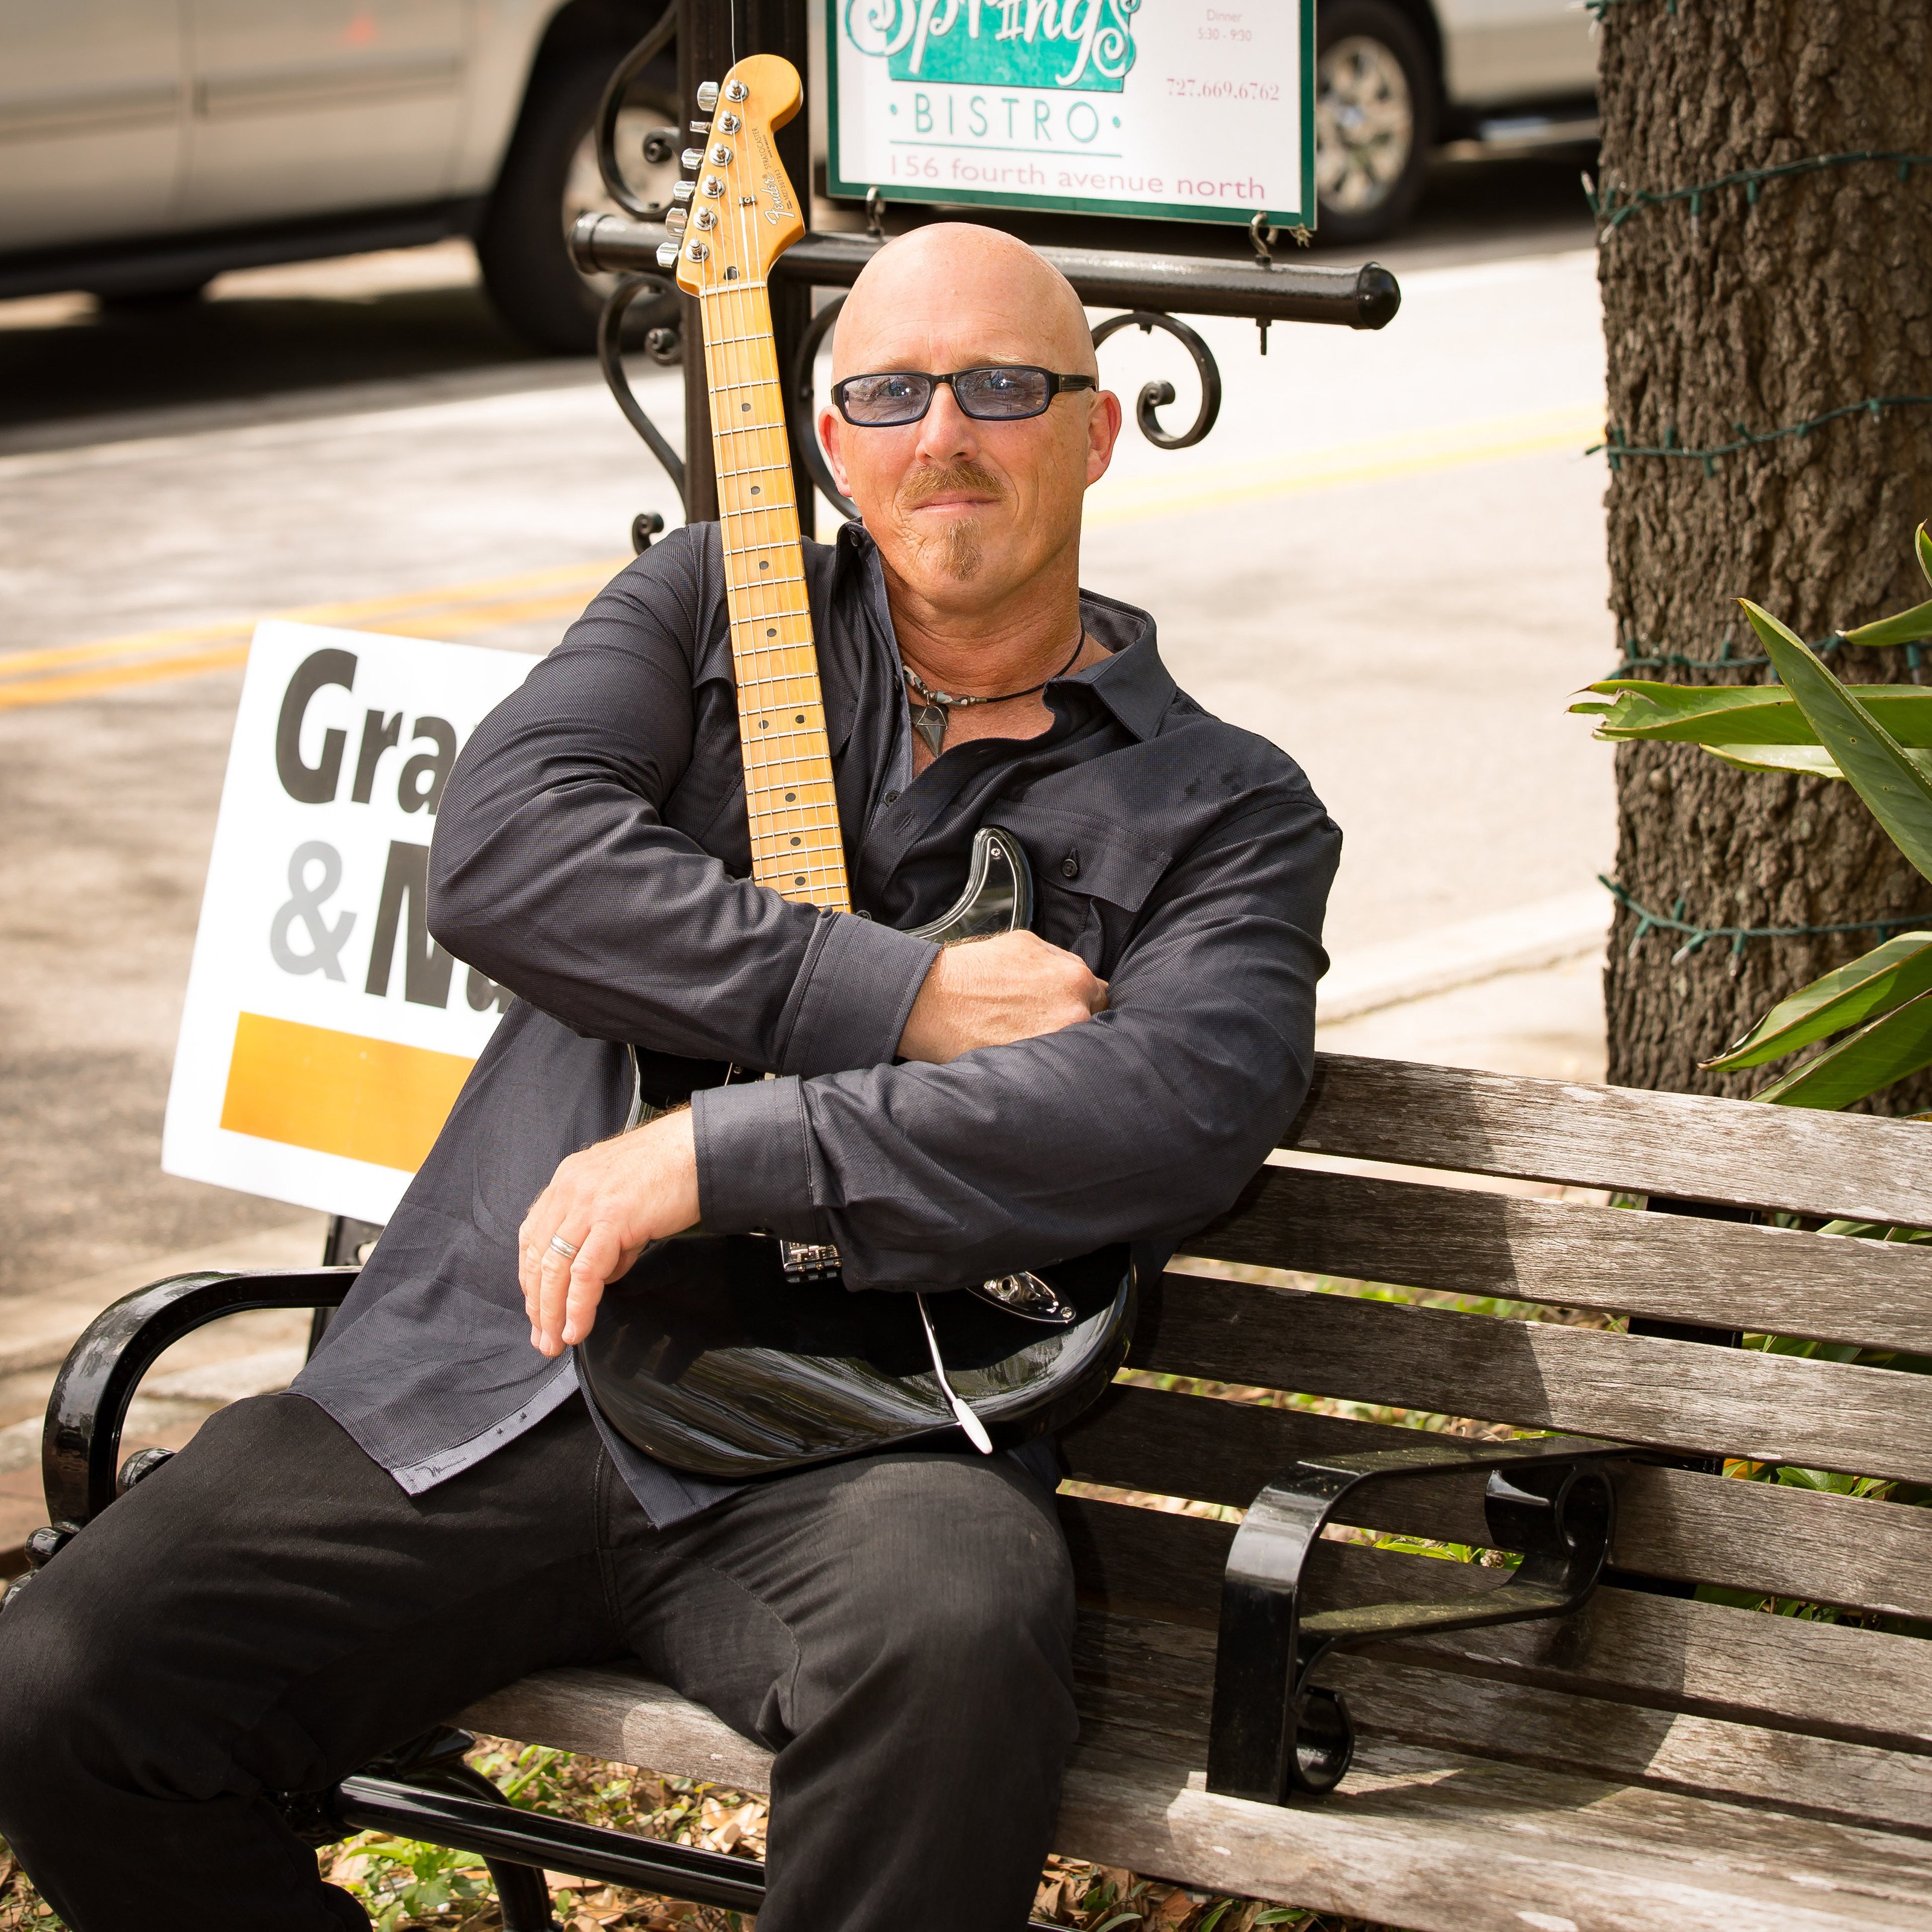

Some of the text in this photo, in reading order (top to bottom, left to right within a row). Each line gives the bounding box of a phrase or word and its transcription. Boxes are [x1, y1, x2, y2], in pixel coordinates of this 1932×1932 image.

[1206, 8, 1243, 23] Dinner
[1166, 78, 1279, 101] 727.669.6762
[752, 126, 772, 170] STRATOCASTER
[890, 155, 1265, 200] 156 fourth avenue north
[272, 647, 477, 816] Gra
[270, 840, 358, 984] &
